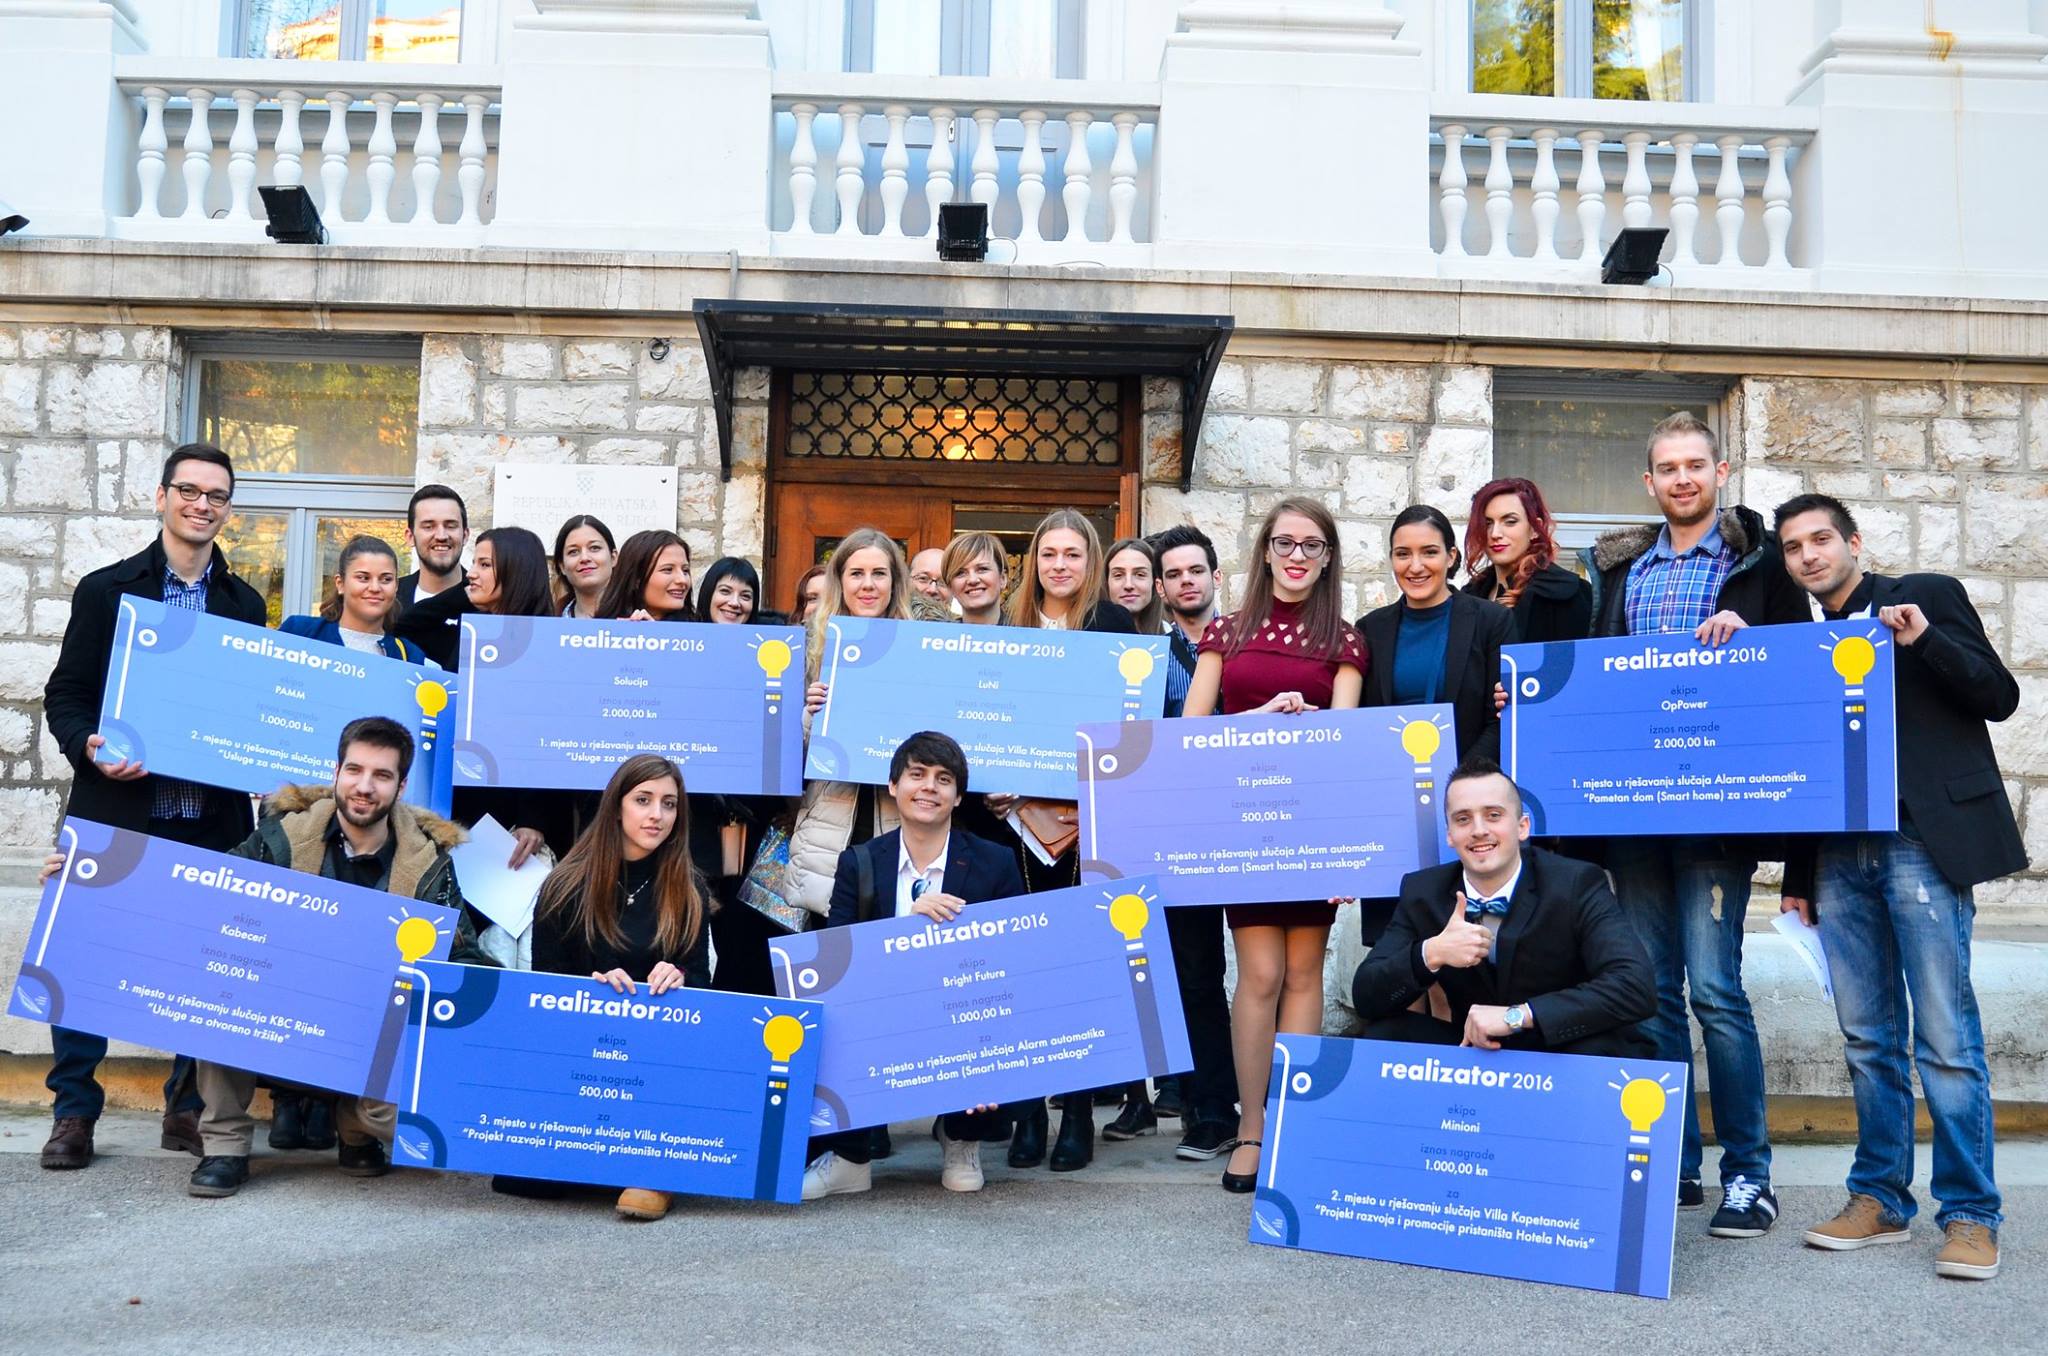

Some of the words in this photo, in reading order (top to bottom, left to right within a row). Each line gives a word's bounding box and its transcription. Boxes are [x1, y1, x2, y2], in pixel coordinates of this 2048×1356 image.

[560, 629, 669, 650] realizator
[672, 638, 704, 651] 2016
[921, 634, 1030, 655] realizator
[1032, 644, 1064, 657] 2016
[222, 634, 331, 669] realizator
[333, 661, 365, 678] 2016
[1604, 647, 1726, 671] realizator
[1729, 647, 1767, 663] 2016
[275, 686, 304, 699] PAMM
[1661, 699, 1707, 712] OpPower
[261, 714, 301, 730] 1.000,00
[304, 721, 313, 732] kn
[1183, 726, 1302, 749] realizator
[1305, 728, 1341, 742] 2016
[1654, 737, 1700, 748] 2.000,00
[1704, 736, 1715, 746] kn
[1237, 777, 1249, 785] Tri
[1572, 778, 1580, 788] 1.
[1583, 778, 1613, 790] mjesto
[1714, 773, 1745, 784] Alarm
[1748, 771, 1806, 783] automatika
[1632, 791, 1654, 802] dom
[1657, 790, 1689, 803] (Smart
[1692, 789, 1724, 801] home)
[1242, 811, 1277, 821] 500,00
[1280, 810, 1291, 819] kn
[1154, 851, 1164, 861] 3.
[1167, 851, 1197, 862] mjesto
[1298, 845, 1327, 854] Alarm
[1330, 841, 1384, 853] automatika
[1217, 863, 1238, 873] dom
[1241, 862, 1274, 873] (Smart
[1276, 859, 1307, 870] home)
[171, 863, 299, 905] realizator
[300, 894, 338, 915] 2016
[221, 924, 266, 943] Kabeceri
[884, 919, 1007, 953] realizator
[1010, 912, 1048, 931] 2016
[206, 961, 245, 978] 500,00
[247, 970, 259, 981] kn
[943, 973, 972, 987] Bright
[974, 970, 1005, 981] Future
[118, 979, 128, 990] 3.
[132, 985, 165, 999] mjesto
[269, 1015, 292, 1028] KBC
[294, 1020, 325, 1036] Rijeka
[529, 990, 660, 1019] realizator
[662, 1006, 701, 1024] 2016
[951, 1007, 996, 1023] 1.000,00
[999, 1006, 1011, 1015] kn
[189, 1015, 203, 1024] za
[205, 1018, 251, 1035] otvoreno
[593, 1049, 628, 1061] InteRio
[868, 1066, 879, 1076] 2.
[882, 1062, 914, 1076] mjesto
[1017, 1039, 1047, 1051] Alarm
[1050, 1027, 1105, 1045] automatika
[936, 1070, 958, 1080] dom
[961, 1063, 994, 1078] (Smart
[997, 1055, 1028, 1070] home)
[1032, 1056, 1044, 1064] za
[1381, 1058, 1510, 1087] realizator
[1512, 1073, 1552, 1091] 2016
[579, 1086, 618, 1098] 500,00
[621, 1089, 632, 1100] kn
[479, 1114, 489, 1124] 3.
[493, 1116, 526, 1128] mjesto
[634, 1129, 656, 1141] Villa
[1441, 1120, 1479, 1132] Minioni
[506, 1135, 545, 1147] razvoja
[554, 1140, 606, 1153] promocije
[664, 1148, 698, 1160] Hotela
[1426, 1159, 1472, 1175] 1.000,00
[1476, 1165, 1488, 1176] kn
[1331, 1190, 1340, 1200] 2.
[1344, 1193, 1376, 1205] mjesto
[1484, 1208, 1507, 1221] Villa
[1356, 1213, 1394, 1226] razvoja
[1403, 1218, 1455, 1234] promocije
[1516, 1229, 1552, 1244] Hotela
